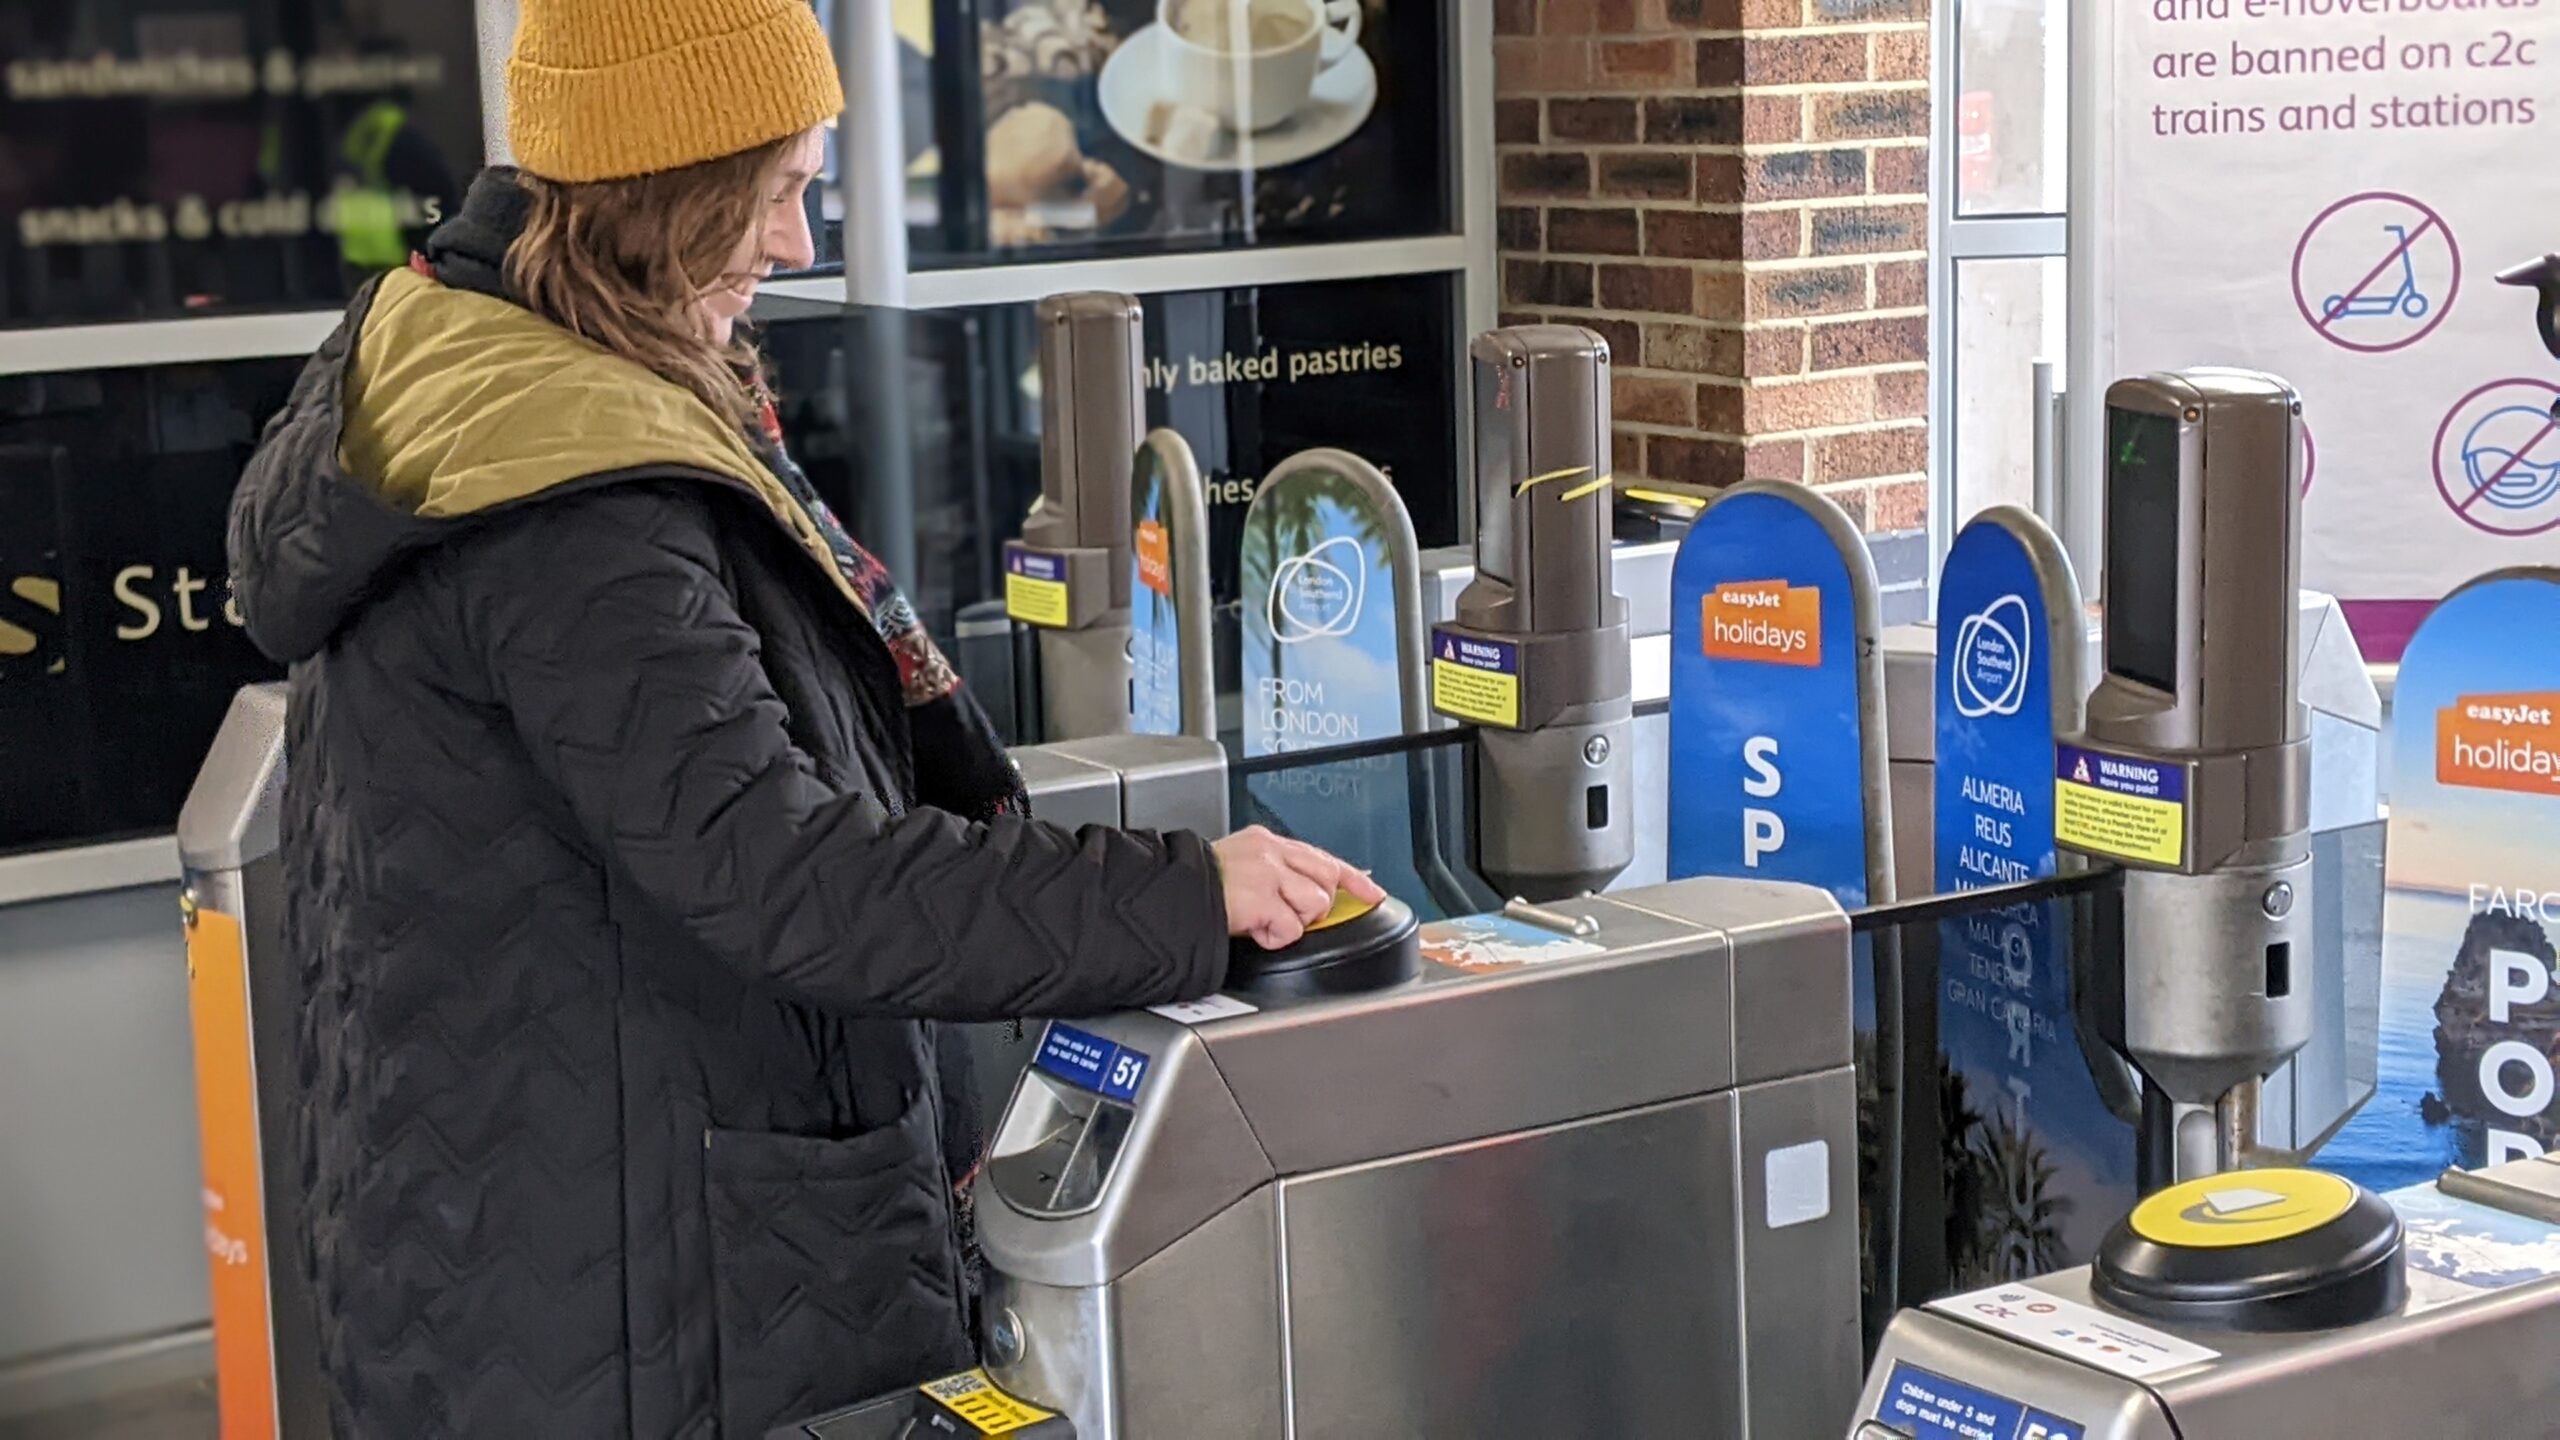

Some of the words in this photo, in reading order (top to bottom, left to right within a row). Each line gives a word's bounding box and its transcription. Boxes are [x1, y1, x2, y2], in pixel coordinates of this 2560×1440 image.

[2153, 48, 2217, 79] are
[2231, 35, 2387, 76] banned
[2400, 41, 2451, 71] on
[2466, 31, 2537, 68] c2c
[2153, 102, 2265, 136] trains
[2278, 94, 2356, 131] and
[2370, 93, 2536, 129] stations
[1188, 346, 1279, 385] baked
[1290, 341, 1402, 383] pastries
[1721, 590, 1781, 608] easyJet
[1460, 641, 1501, 660] WARNING
[1714, 616, 1808, 653] holidays
[1259, 677, 1324, 704] FROM
[1261, 708, 1359, 738] LONDON
[2466, 704, 2551, 725] easyJet
[2100, 760, 2159, 783] WARNING
[2100, 777, 2119, 788] Have
[2120, 781, 2134, 791] you
[2136, 784, 2159, 795] paid?
[1962, 775, 2024, 815] ALMERIA
[1975, 813, 2012, 848] REUS
[1960, 845, 2030, 883] ALICANTE
[1113, 1055, 1143, 1090] 51
[1895, 1399, 1917, 1417] dogs
[1918, 1408, 1942, 1425] must
[1942, 1414, 1956, 1430] be
[1958, 1422, 1995, 1440] carried
[1901, 1382, 1936, 1403] Children
[1937, 1395, 1964, 1414] under
[1965, 1405, 1974, 1418] 5
[1975, 1411, 1996, 1427] and
